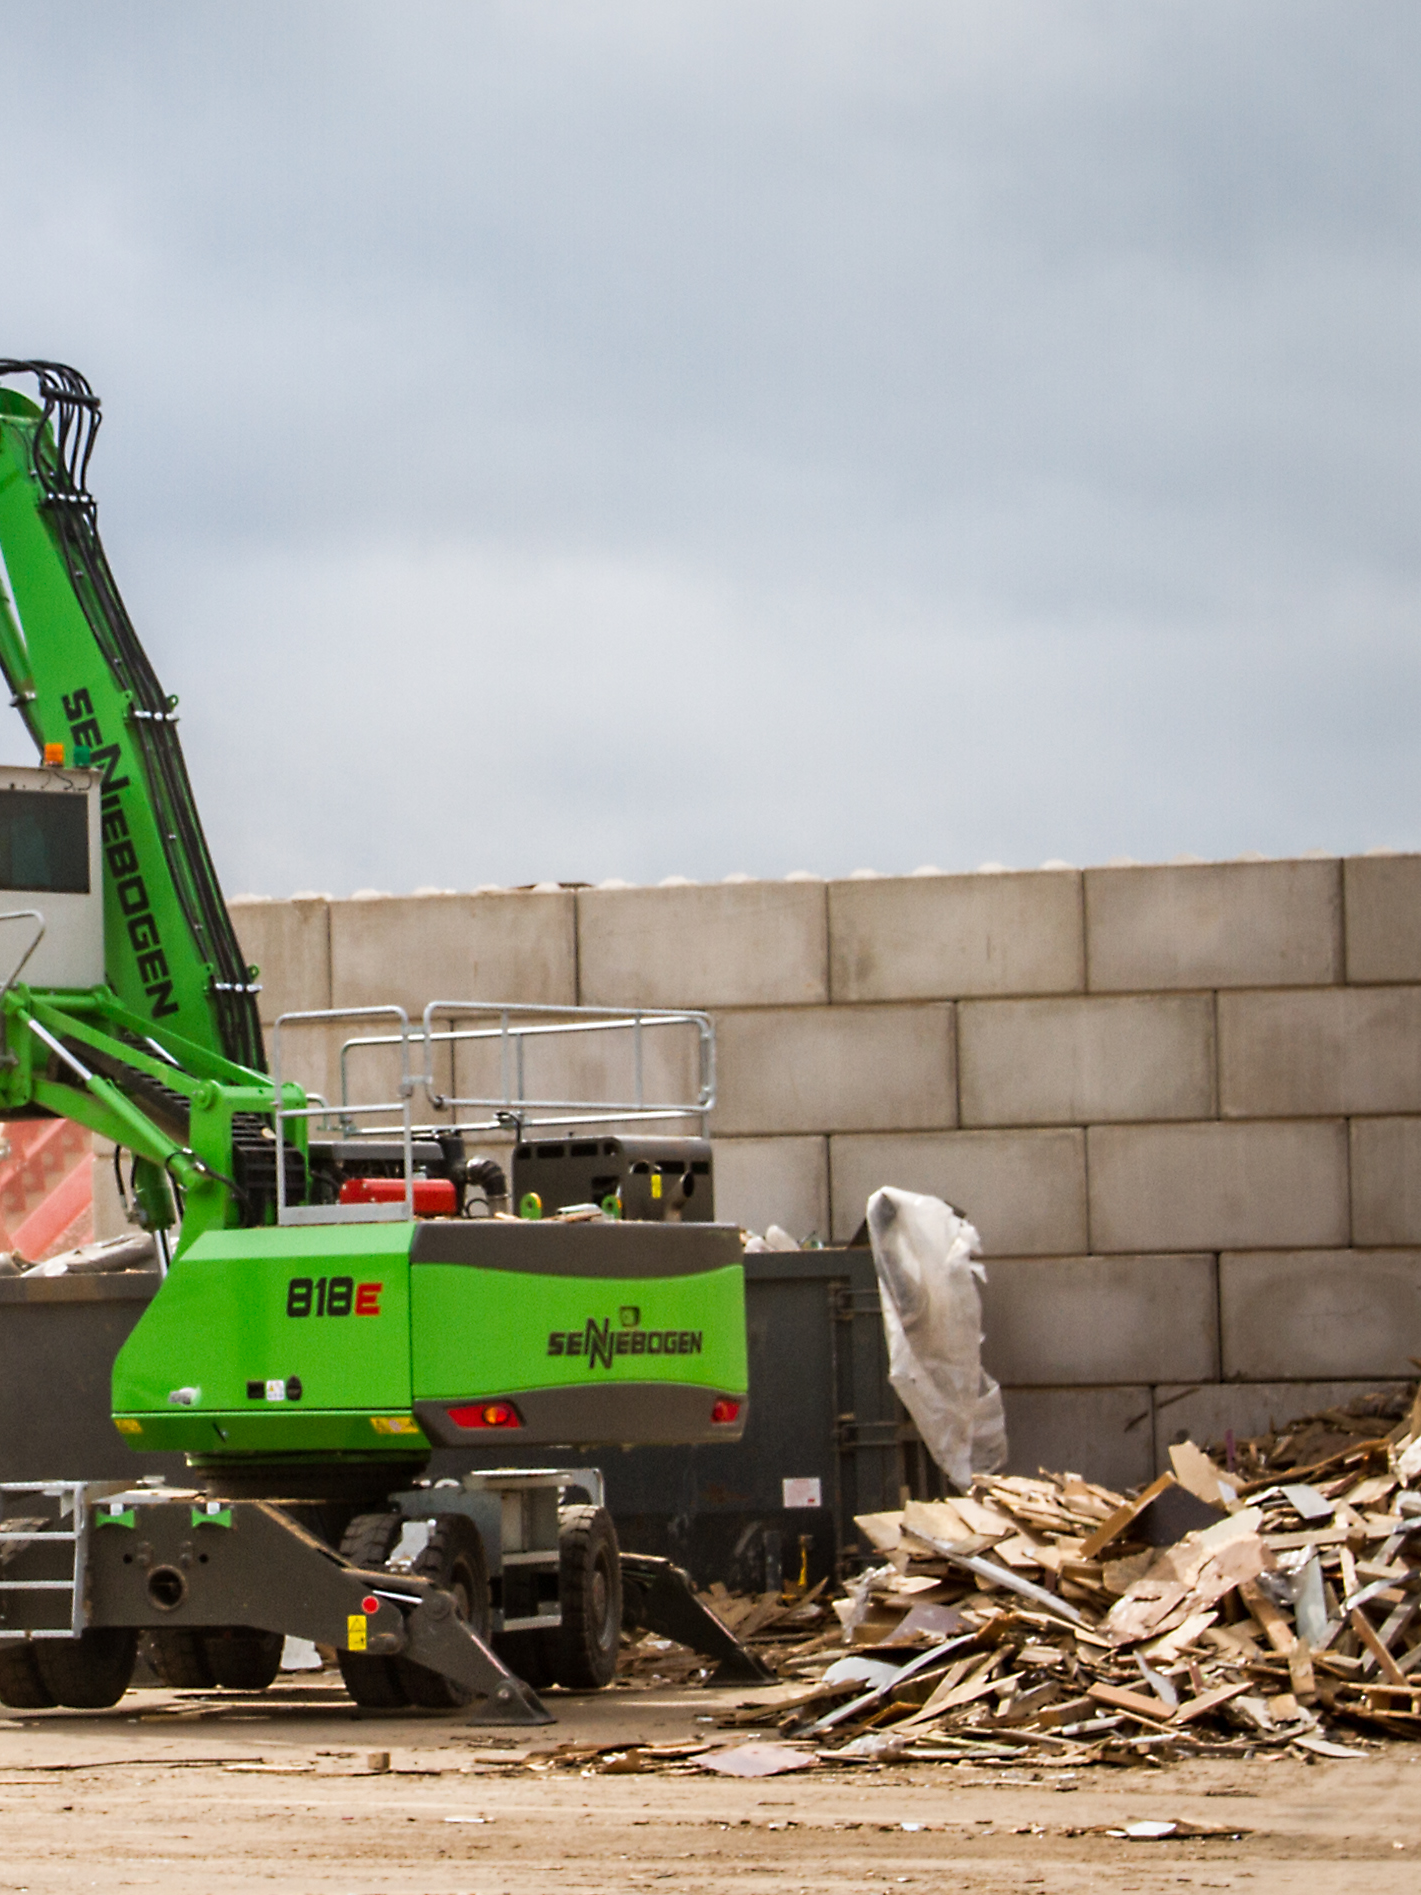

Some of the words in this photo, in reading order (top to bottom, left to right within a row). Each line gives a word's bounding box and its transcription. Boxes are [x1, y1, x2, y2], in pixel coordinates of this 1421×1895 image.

[62, 687, 179, 1019] SENEBOGEN
[286, 1276, 383, 1317] 818E
[547, 1317, 702, 1369] SENNEBOGEN
